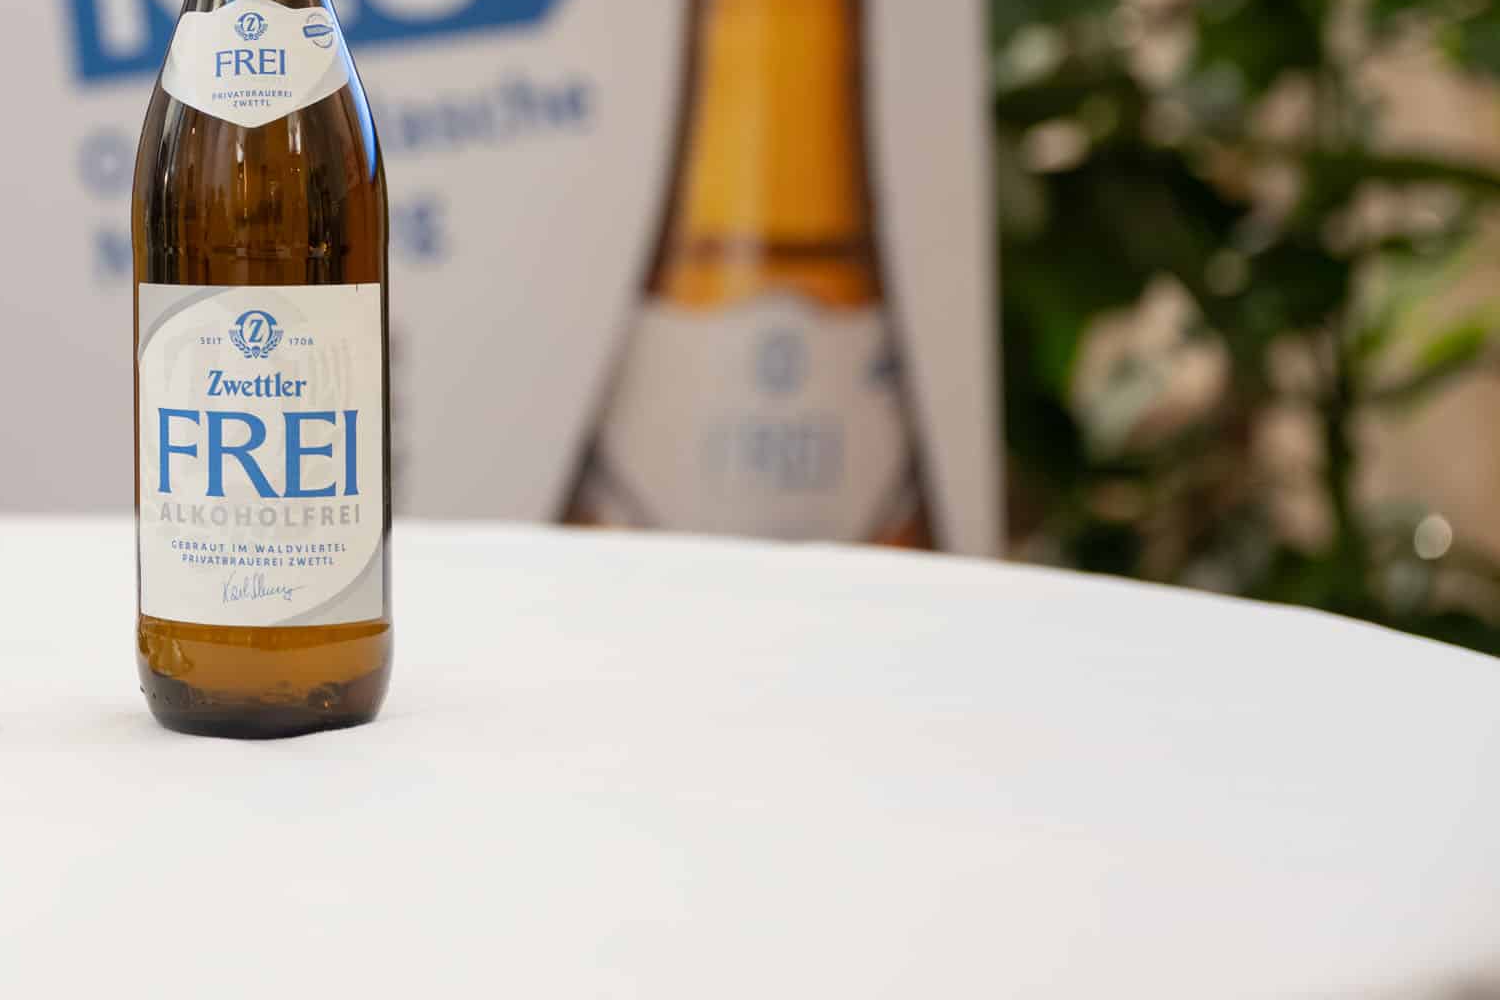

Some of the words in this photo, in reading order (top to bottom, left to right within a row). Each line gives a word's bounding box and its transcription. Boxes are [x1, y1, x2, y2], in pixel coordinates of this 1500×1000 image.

[215, 47, 287, 77] FREI
[211, 89, 293, 101] PRIVATBRAUEREI
[199, 336, 222, 345] SEIT
[206, 369, 308, 398] Zwettler
[158, 407, 360, 498] FREI
[159, 502, 361, 528] ALKOHOLFREI
[171, 539, 225, 553] GEBRAUT
[232, 543, 248, 553] IM
[254, 543, 347, 554] WALDVIERTEL
[181, 554, 284, 567] PRIVATBRAUEREI
[288, 556, 334, 567] ZWETTL
